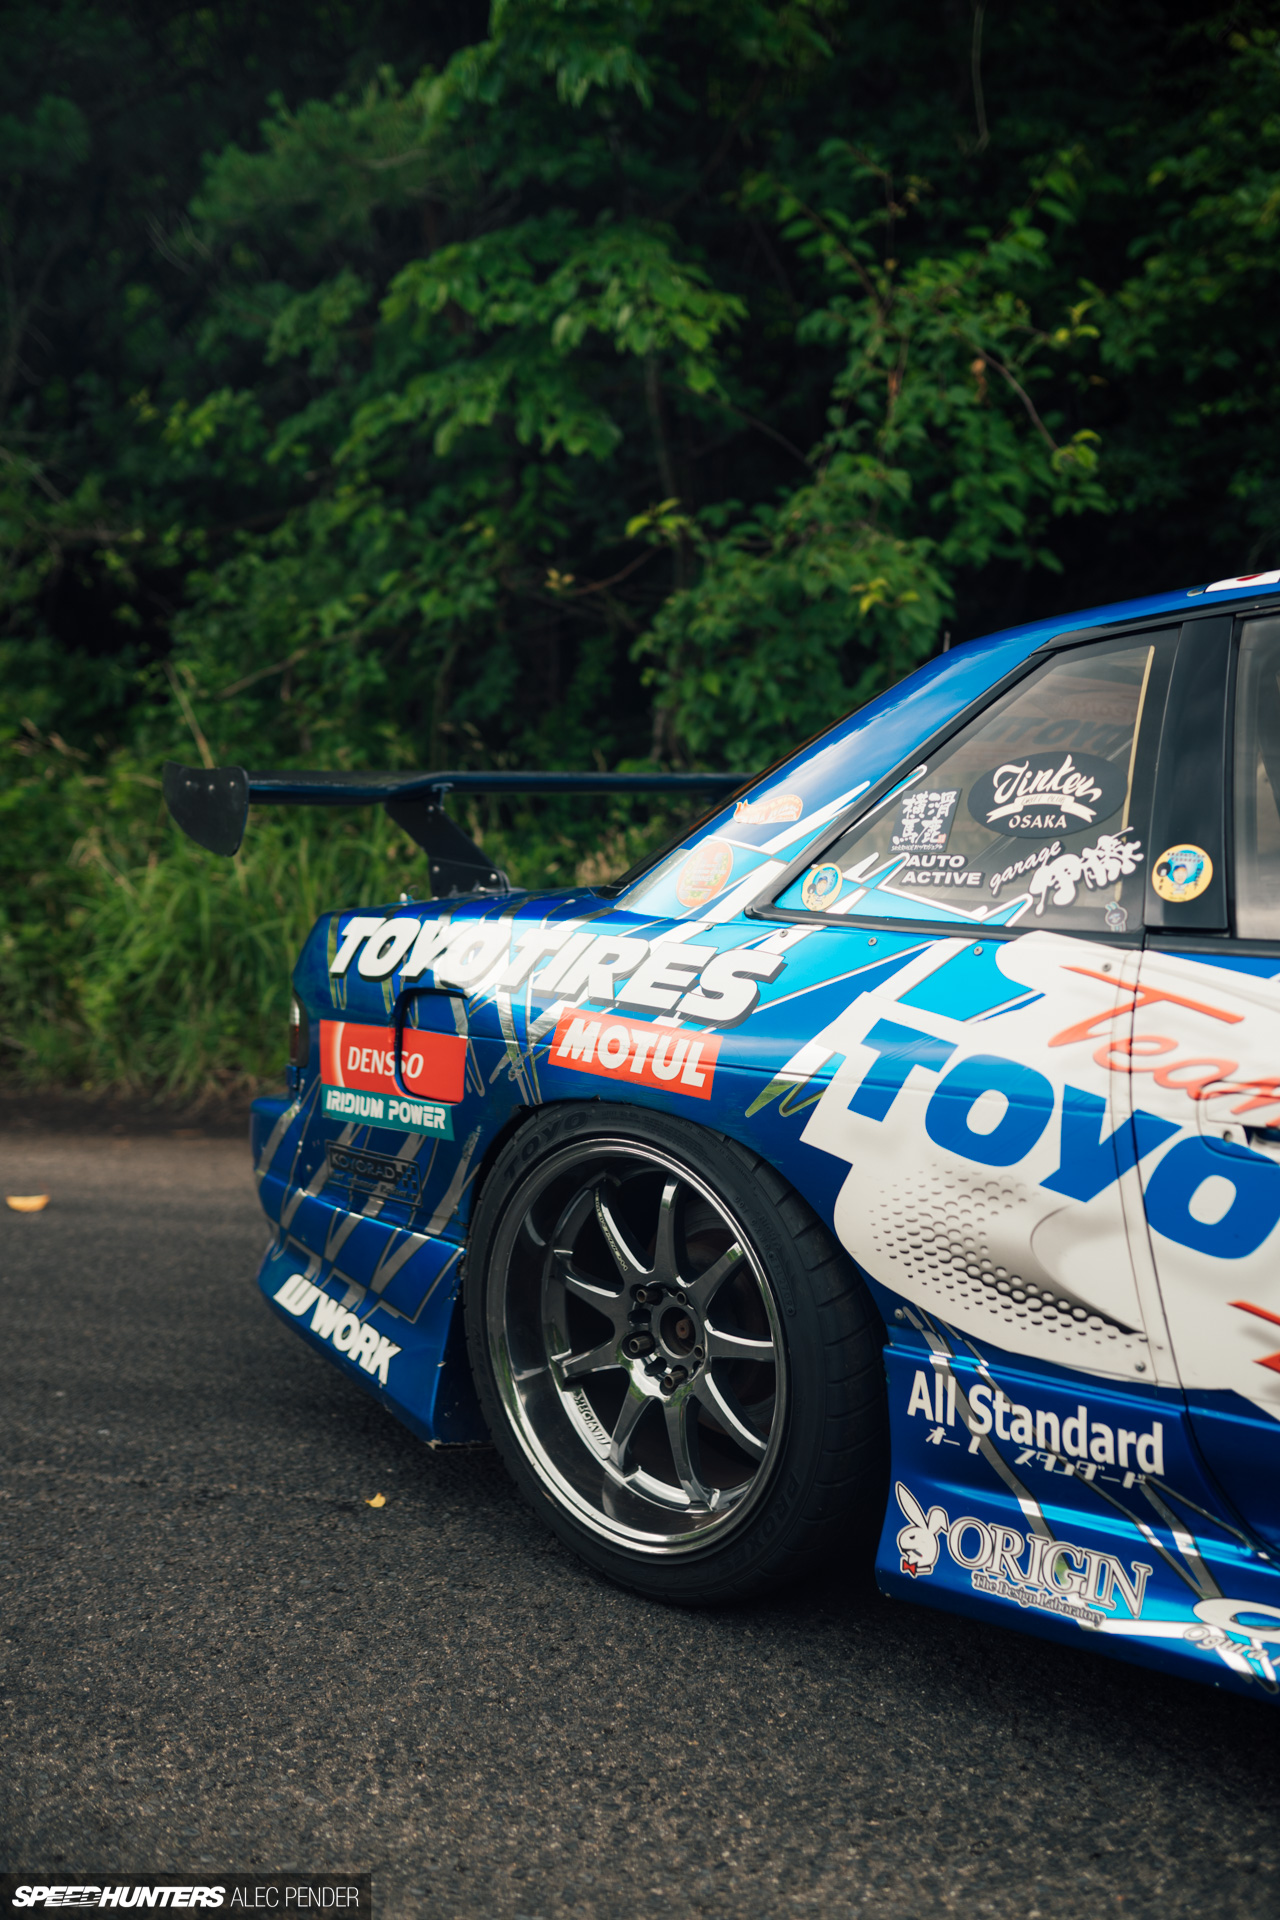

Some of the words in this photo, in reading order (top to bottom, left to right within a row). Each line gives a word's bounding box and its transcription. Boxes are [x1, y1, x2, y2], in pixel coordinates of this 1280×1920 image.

[1008, 814, 1067, 829] OSAKA
[901, 871, 982, 886] ACTIVE
[905, 854, 966, 869] AUTO
[989, 840, 1062, 896] garage
[347, 1046, 424, 1079] DENSO
[556, 1016, 708, 1088] MOTUL
[326, 1090, 384, 1119] IRIDIUM
[388, 1099, 446, 1130] POWER
[503, 1111, 588, 1180] TOYO
[846, 1017, 1280, 1260] TOYO
[310, 1294, 403, 1386] WORK
[906, 1370, 957, 1427] All
[968, 1383, 1166, 1477] Standard
[948, 1516, 1153, 1619] ORIGIN
[972, 1573, 997, 1592] The
[997, 1580, 1038, 1606] Design
[1038, 1592, 1106, 1628] Laboratory
[1183, 1626, 1269, 1661] Ogura
